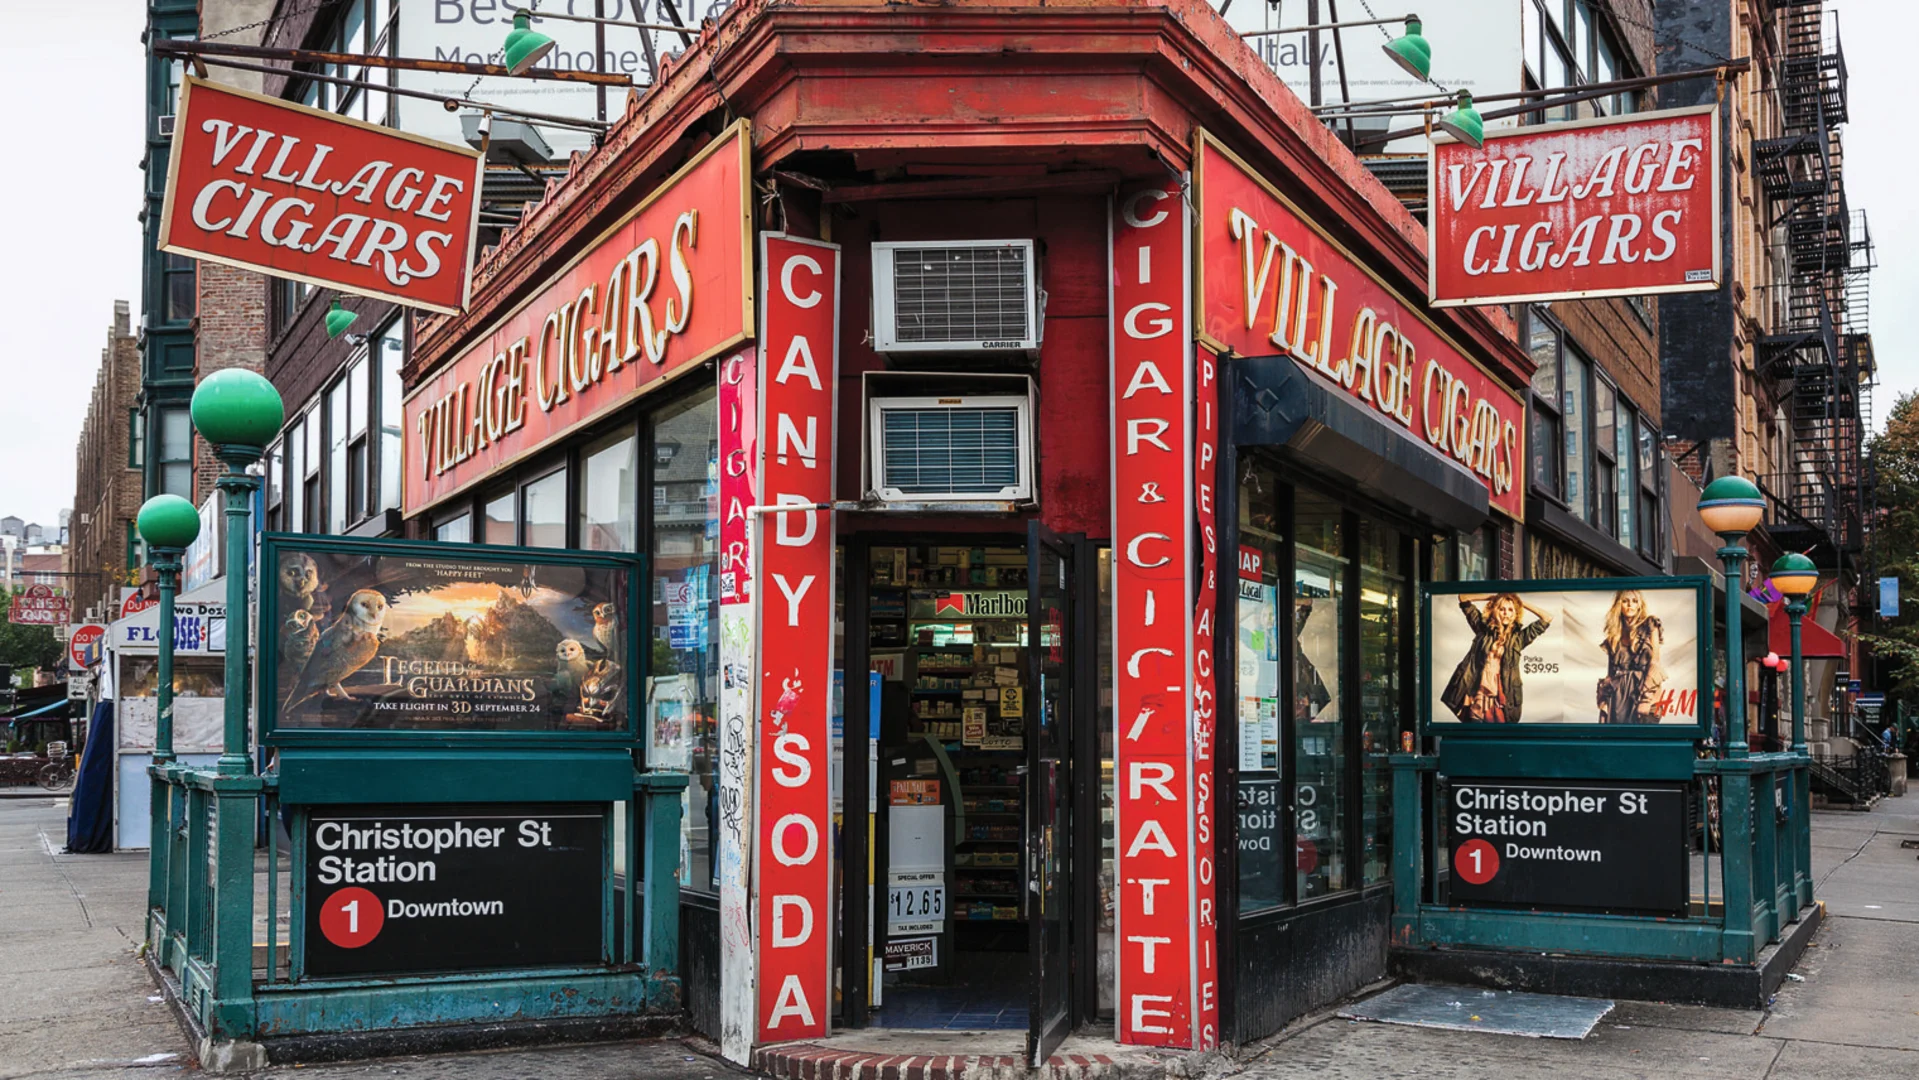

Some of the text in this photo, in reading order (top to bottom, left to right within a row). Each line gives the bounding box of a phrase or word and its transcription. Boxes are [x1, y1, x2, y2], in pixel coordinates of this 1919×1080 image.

[202, 119, 463, 223] VILLAGE
[1448, 138, 1702, 212] VILLAGE
[192, 178, 453, 286] CIGARS
[1463, 210, 1682, 276] CIGARS
[1121, 188, 1174, 456] CIGAR
[417, 208, 698, 481] VILLAGE CIGARS
[1228, 207, 1516, 496] VILLAGE CIGARS
[772, 254, 822, 626] CANDY
[726, 354, 746, 570] CIGAR
[1138, 481, 1166, 503] &
[128, 600, 142, 610] DO
[174, 606, 193, 614] wo
[379, 656, 464, 687] LEGEND
[1524, 663, 1559, 674] $39.95
[407, 676, 536, 701] GUARDIANS
[1654, 688, 1698, 717] H&M
[374, 702, 397, 710] TAKE
[400, 703, 434, 711] FLIGHT
[451, 701, 472, 714] 3D
[474, 704, 527, 712] SEPTEMBER
[529, 704, 540, 712] 24
[1197, 360, 1216, 1050] PIPES & ACCESSORIES
[1456, 788, 1648, 816] Christopher St
[316, 820, 552, 853] Christopher St
[1456, 813, 1546, 836] Station
[318, 856, 436, 884] Station
[1469, 844, 1601, 873] 1 Downtown
[767, 733, 818, 1029] SODA
[341, 899, 503, 932] 1 Downtown
[890, 889, 942, 916] $12.65
[885, 942, 931, 954] MAVERICK
